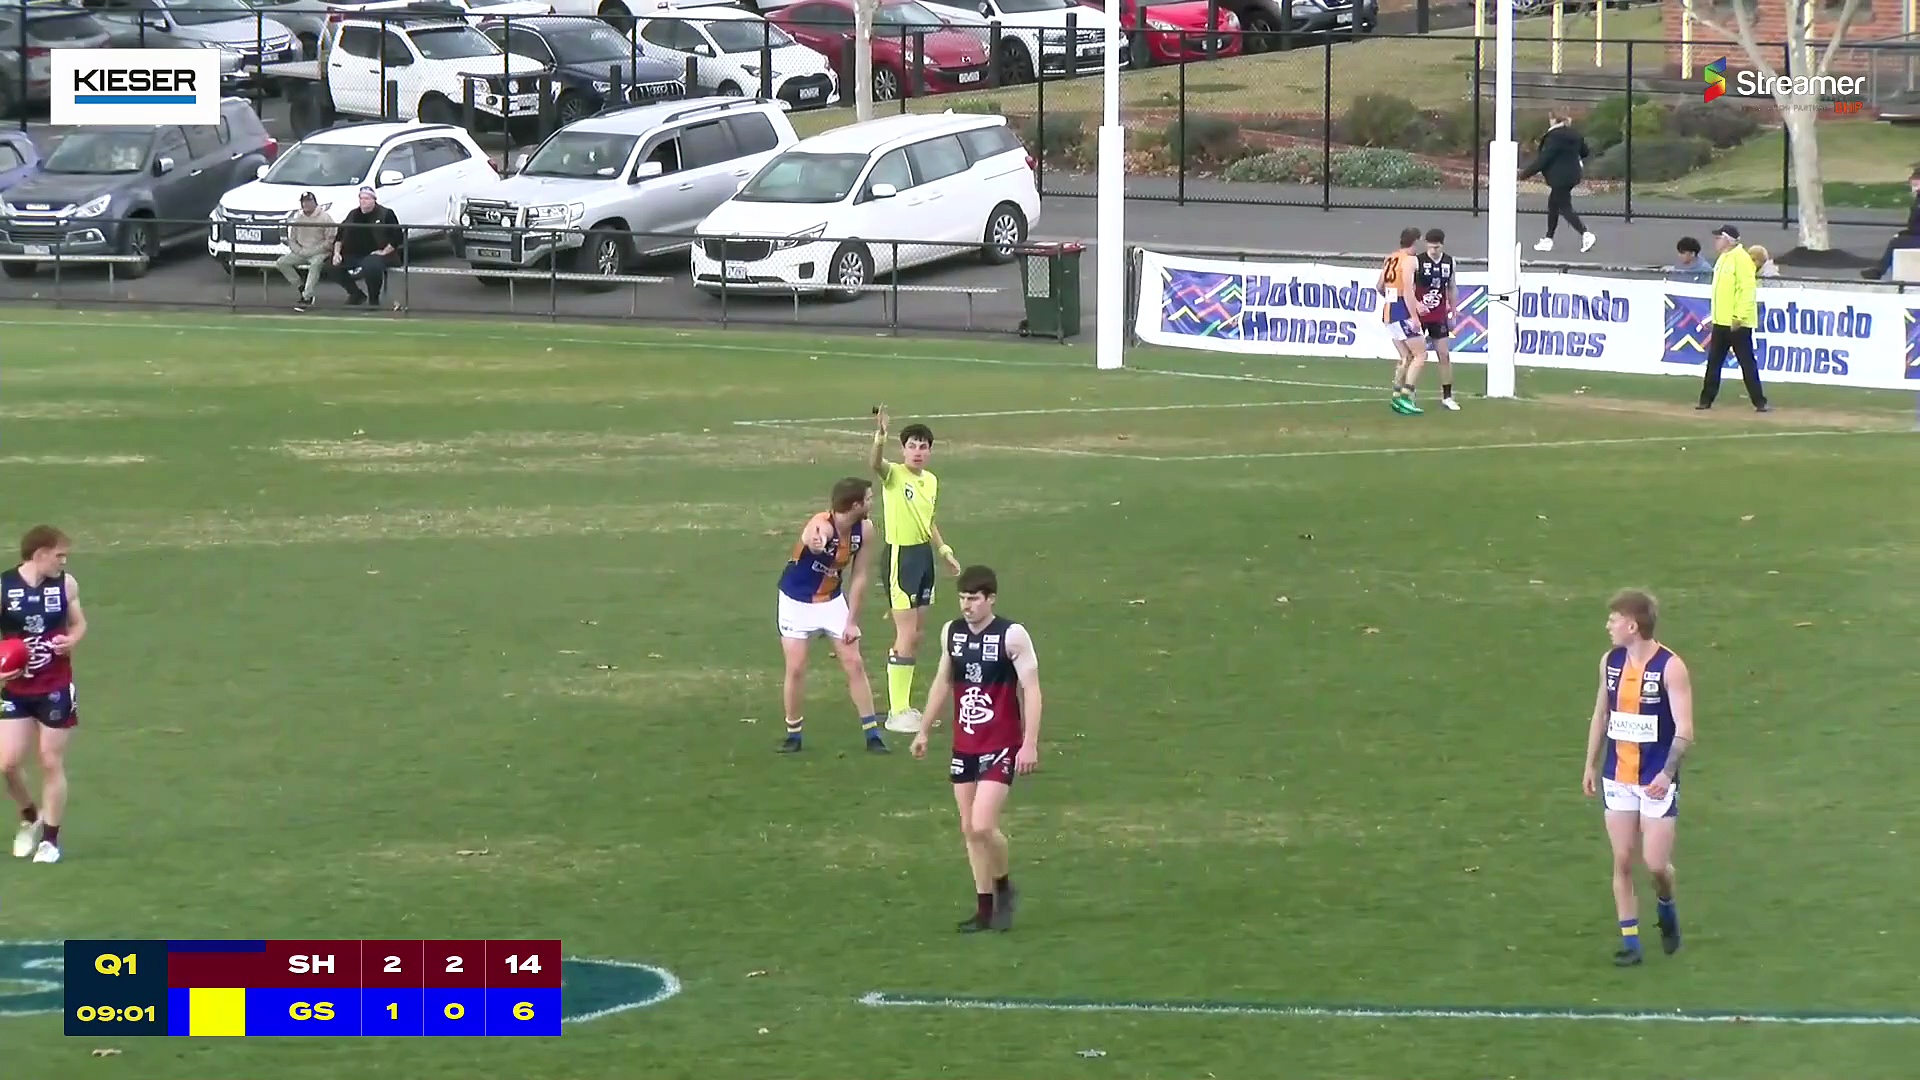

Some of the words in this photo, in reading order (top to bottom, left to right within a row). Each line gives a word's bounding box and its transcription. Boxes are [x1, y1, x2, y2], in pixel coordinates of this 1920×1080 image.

[1383, 255, 1400, 283] 23
[1245, 275, 1378, 313] Hotondo
[1517, 284, 1631, 323] otondo
[1242, 310, 1357, 346] Homes
[1514, 322, 1607, 358] omes
[1613, 719, 1654, 732] NATIONAL
